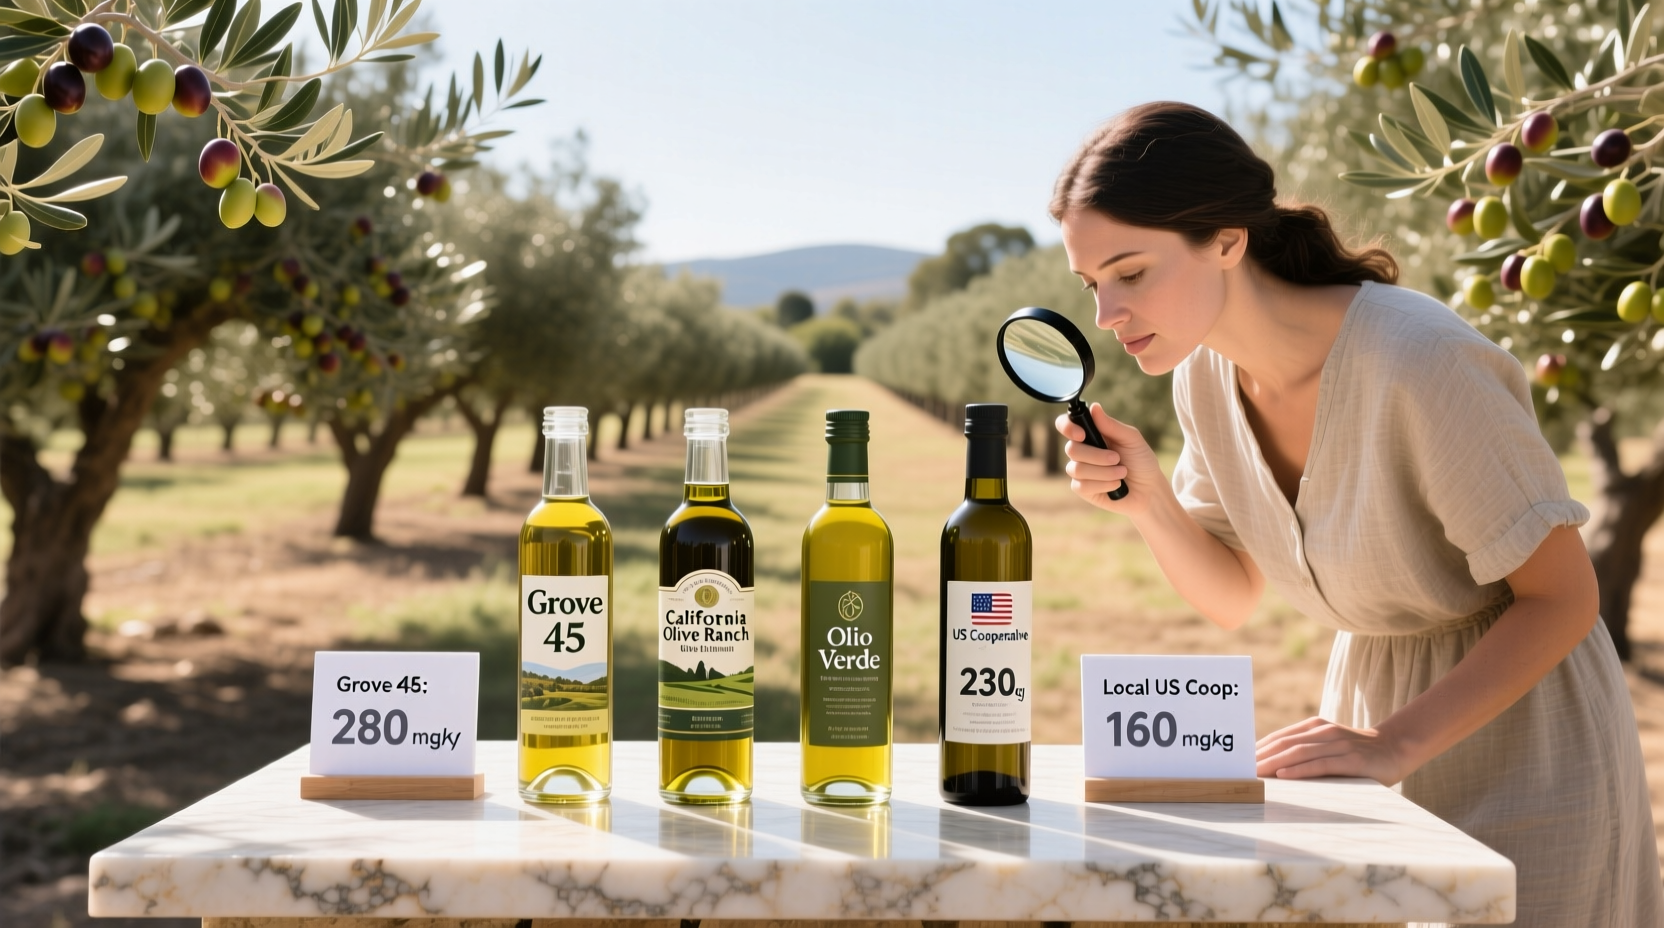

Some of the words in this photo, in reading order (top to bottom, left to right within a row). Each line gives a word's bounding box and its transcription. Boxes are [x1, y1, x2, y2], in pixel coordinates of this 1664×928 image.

[527, 589, 603, 615] Grove
[665, 609, 747, 626] California
[543, 621, 586, 653] 45
[663, 626, 700, 642] Olive
[704, 626, 749, 642] Ranch
[827, 626, 873, 647] Olio
[952, 628, 967, 641] US
[817, 648, 881, 670] Verde
[337, 675, 393, 693] Grove
[396, 675, 428, 694] 45:
[1103, 678, 1150, 696] Local
[1155, 678, 1181, 696] US
[1185, 678, 1239, 700] Coop:
[331, 708, 409, 746] 280
[1106, 710, 1178, 748] 160
[1182, 729, 1234, 752] mgkg
